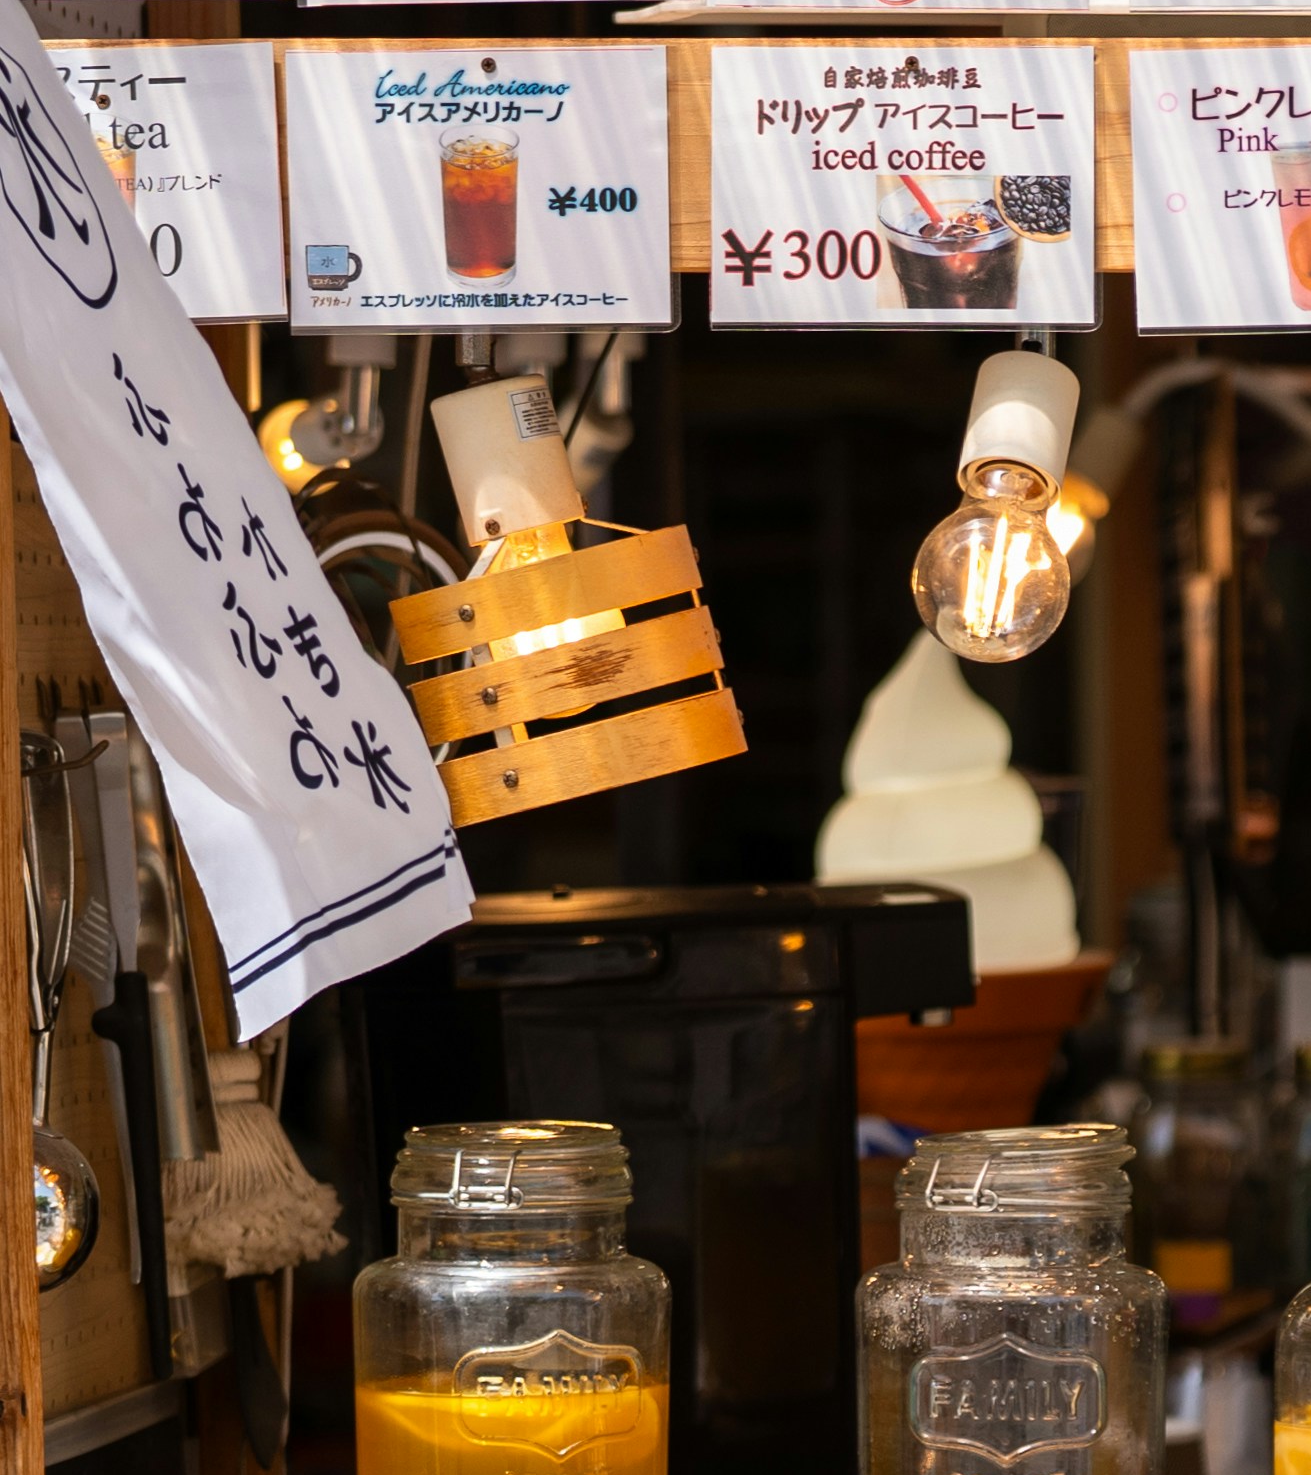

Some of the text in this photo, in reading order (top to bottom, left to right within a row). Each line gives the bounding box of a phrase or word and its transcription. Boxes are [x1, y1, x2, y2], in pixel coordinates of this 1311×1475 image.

[374, 69, 570, 98] Iced Americano
[823, 66, 981, 89] 自家焙煎珈琲豆
[375, 101, 565, 123] アイスアメリカーノ
[757, 98, 1064, 135] ドリップ アイスコーヒー
[109, 119, 170, 150] tea
[1217, 127, 1279, 152] Pink
[812, 140, 985, 171] iced coffee
[548, 186, 637, 216] ¥400
[721, 228, 882, 286] ¥300
[929, 1379, 1085, 1420] FAMILY
